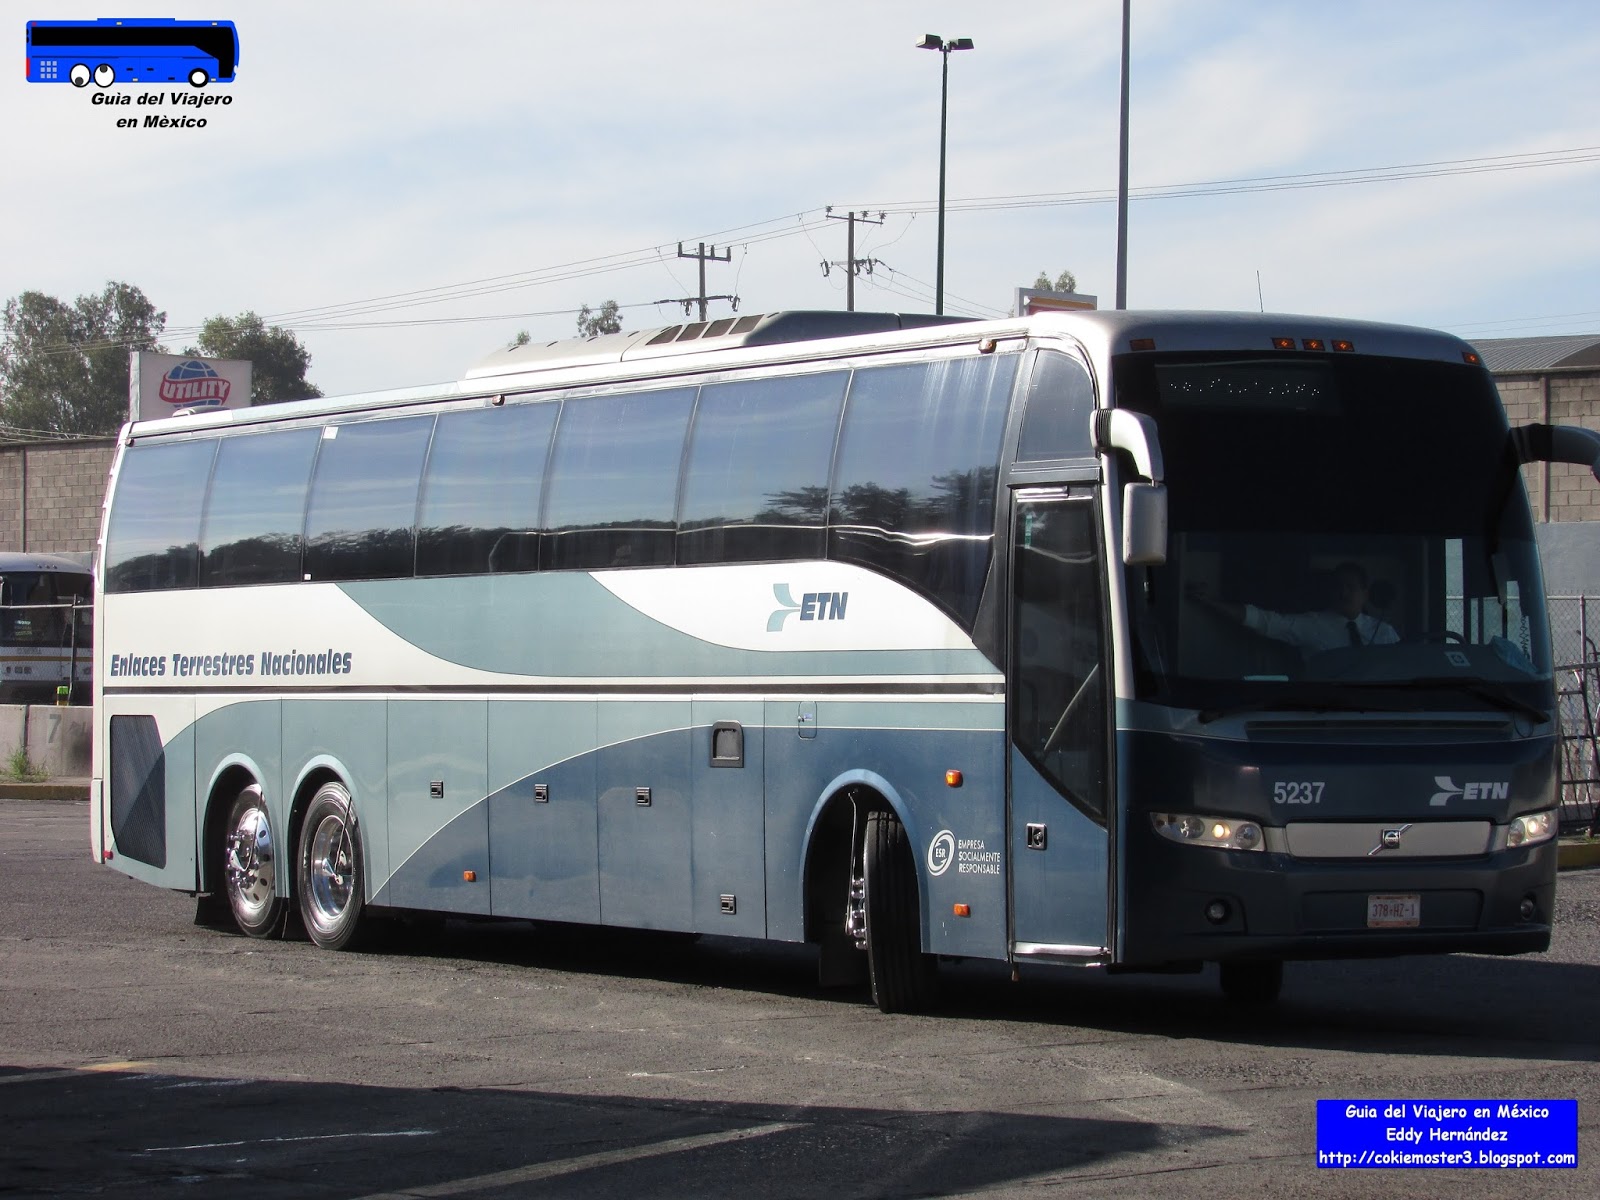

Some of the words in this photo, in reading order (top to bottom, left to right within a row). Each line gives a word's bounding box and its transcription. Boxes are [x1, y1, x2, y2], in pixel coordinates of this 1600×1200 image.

[162, 380, 229, 400] UTILITY
[799, 591, 849, 621] ETN
[110, 653, 166, 677] Enlaces
[172, 651, 255, 677] Terrestres
[260, 649, 352, 676] Nacionales
[48, 713, 62, 744] 7
[1273, 781, 1325, 804] 5237
[1462, 781, 1509, 800] ETN
[935, 848, 946, 858] ESR
[958, 839, 985, 850] EMPRESA
[958, 852, 1001, 863] SOCIALMENTE
[958, 863, 1000, 875] RESPONSABLE
